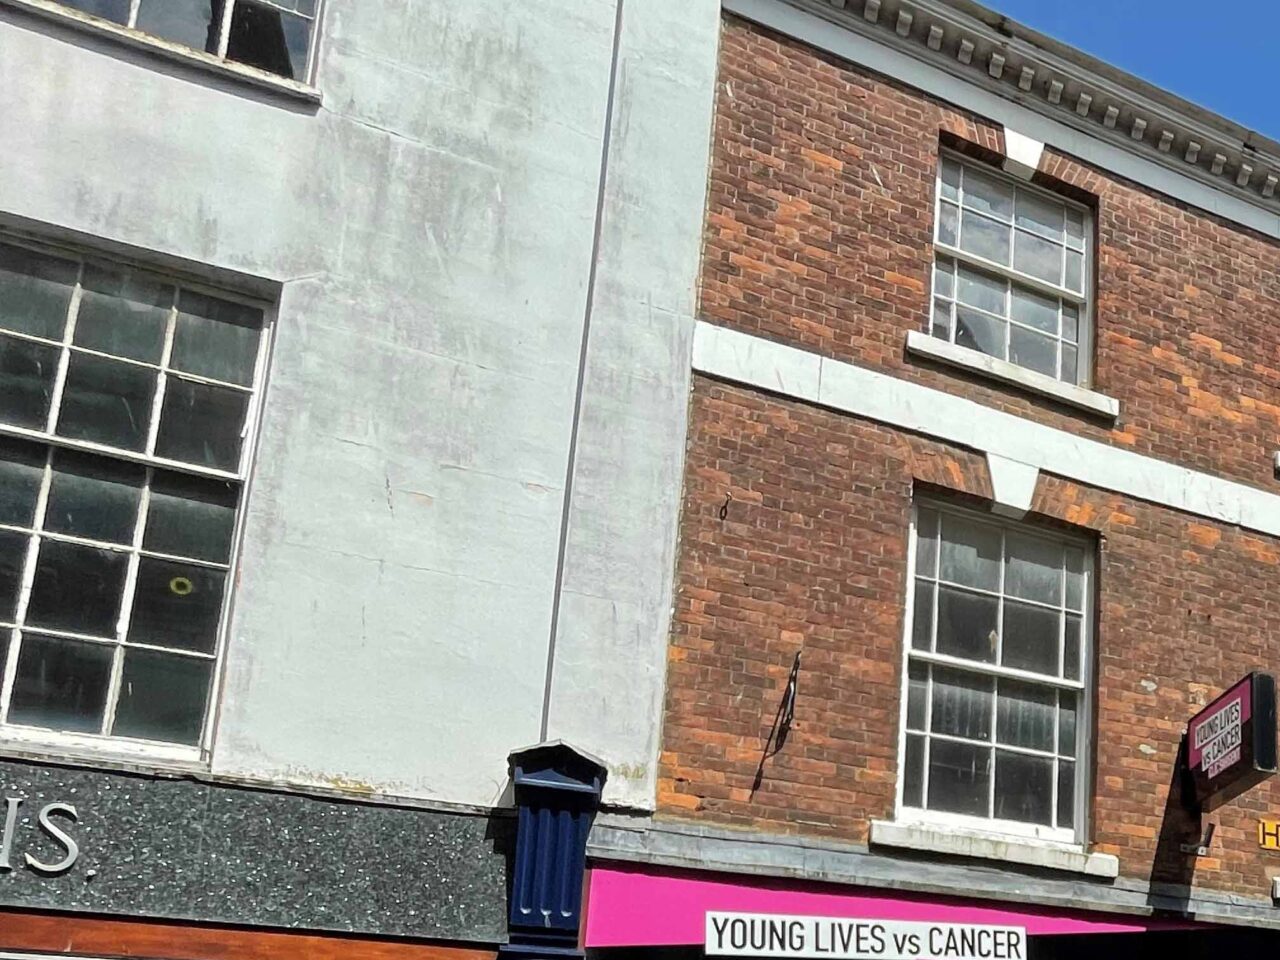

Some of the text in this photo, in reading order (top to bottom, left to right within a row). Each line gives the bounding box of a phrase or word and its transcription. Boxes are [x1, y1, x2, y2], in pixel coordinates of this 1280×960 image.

[1220, 701, 1239, 731] LIVES
[1212, 724, 1240, 761] CANCER
[1262, 822, 1279, 847] H
[712, 917, 1021, 959] YOUNG LIVES vs CANCER
